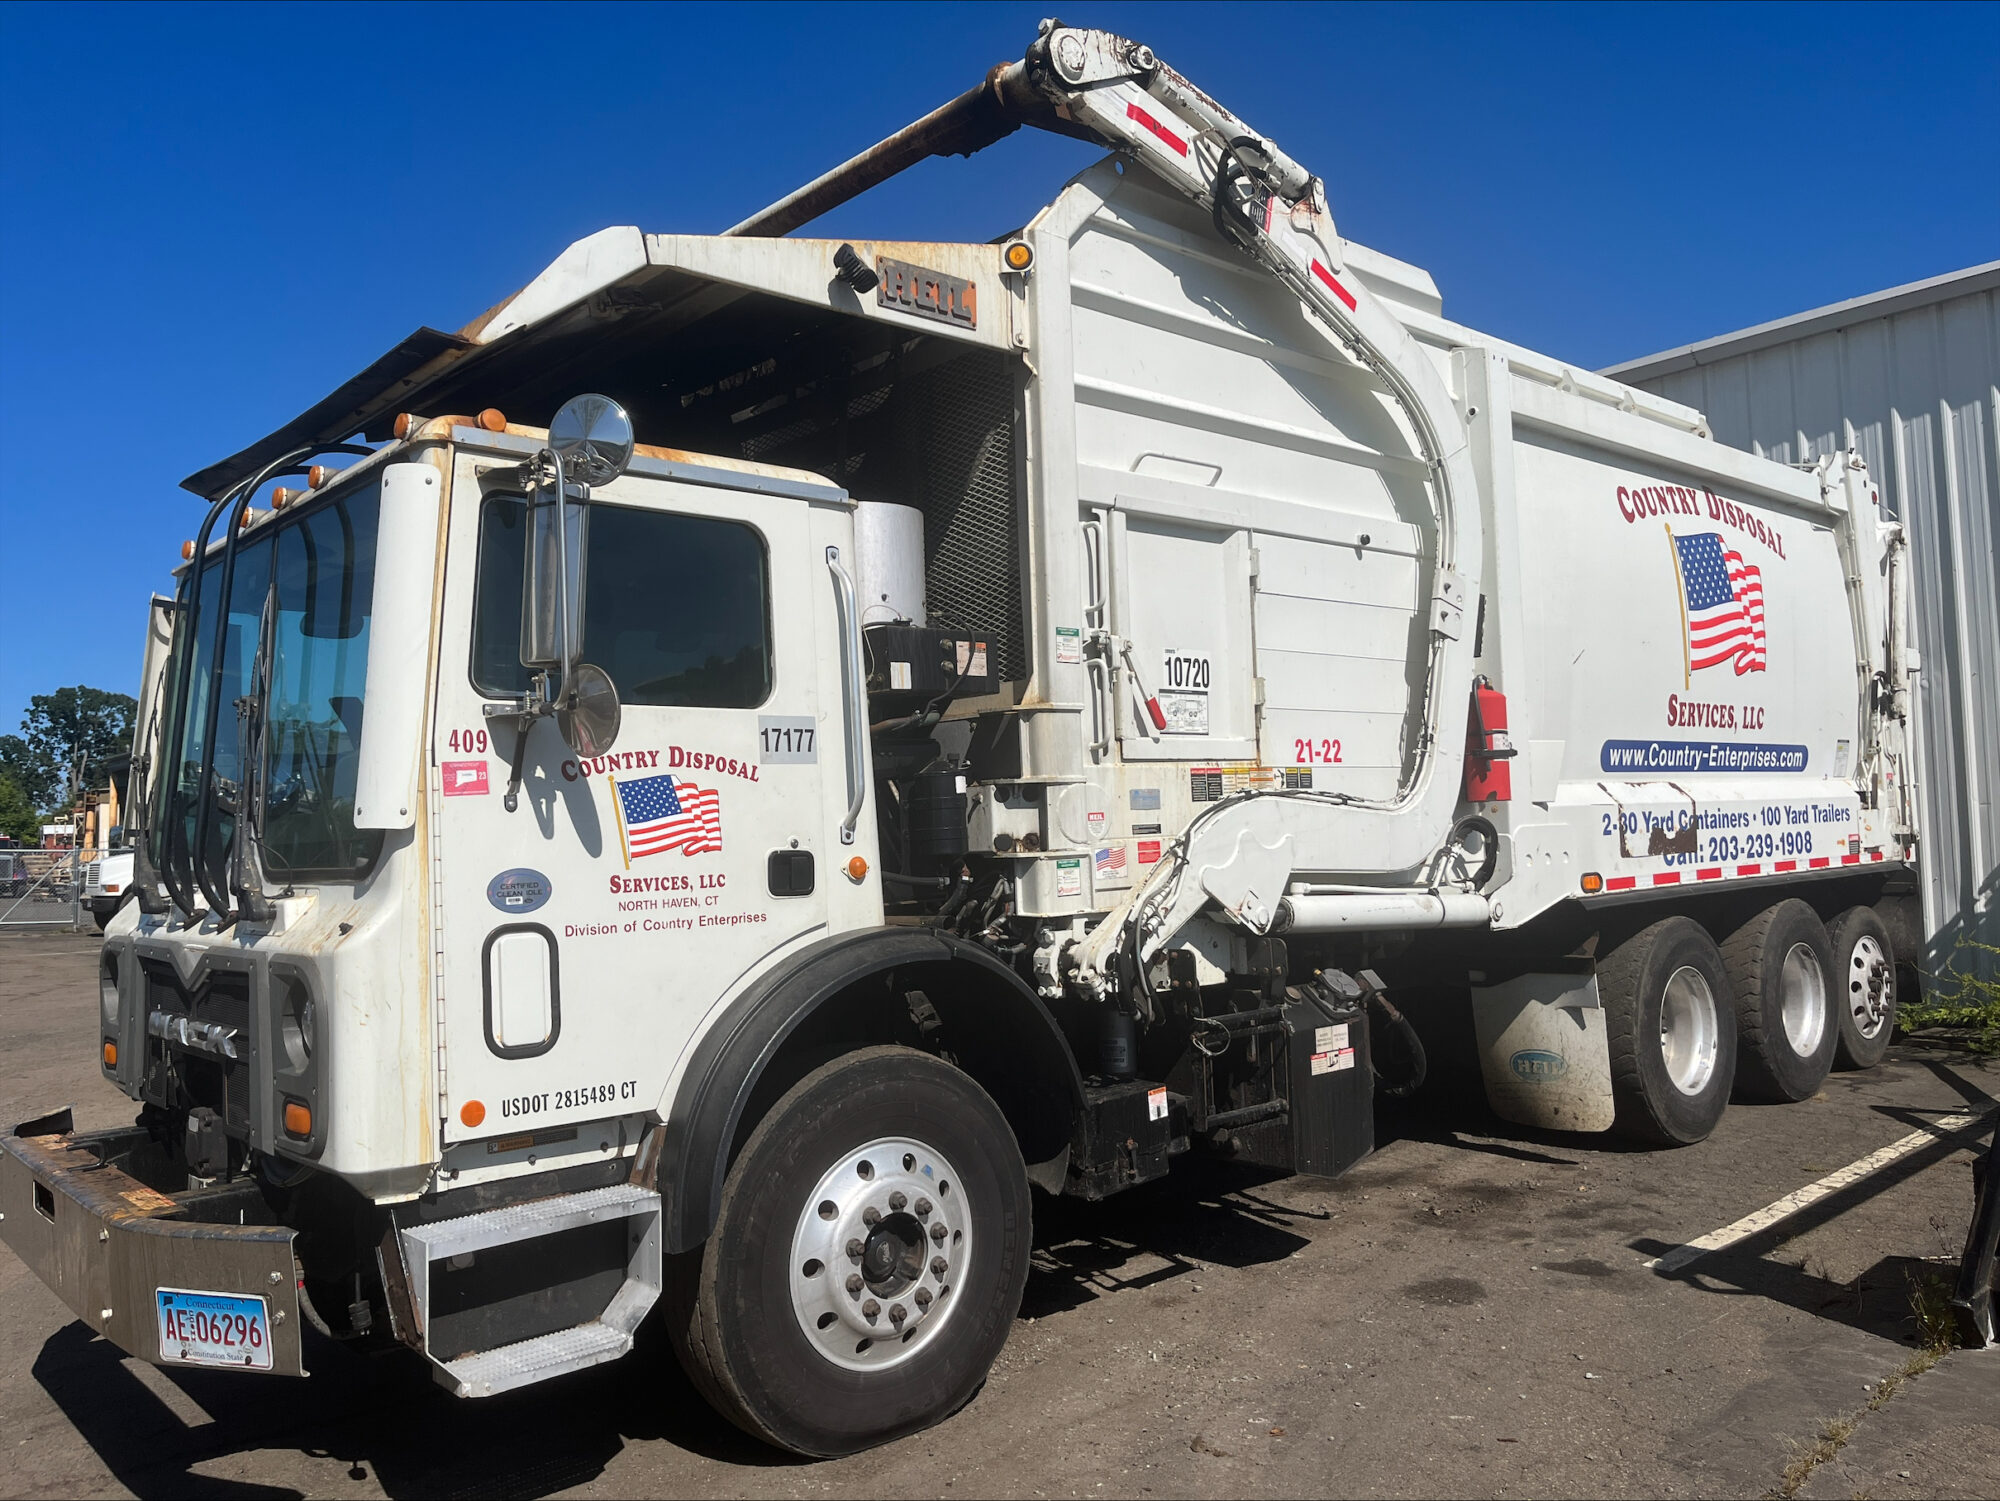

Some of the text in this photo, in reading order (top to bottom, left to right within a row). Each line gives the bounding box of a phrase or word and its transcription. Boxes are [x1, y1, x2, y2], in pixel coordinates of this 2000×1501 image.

[885, 266, 972, 323] HEIL
[1616, 485, 1786, 561] COUNTRY DISPOSAL
[1165, 656, 1210, 688] 10720
[1667, 693, 1765, 734] SERVICES, LLC
[449, 729, 487, 753] 409
[760, 727, 814, 752] 17177
[1295, 738, 1343, 763] 21-22
[561, 746, 760, 783] COUNTRY DISPOSAL
[1609, 743, 1803, 771] www.Country-Enterprises.com
[1641, 810, 1674, 834] Yard
[1760, 806, 1781, 826] 100
[1784, 805, 1809, 825] Yard
[1811, 803, 1851, 823] Trailers
[1708, 831, 1813, 862] 203-239-1908
[500, 882, 539, 890] CERTIFIED
[610, 874, 726, 894] SERVICES, LLC
[618, 896, 719, 912] NORTH HAVEN, CT
[565, 912, 767, 937] Division of Country Enterprises
[502, 1081, 637, 1117] USDOT 2815489 CT
[185, 1297, 235, 1311] Connecticut
[187, 1348, 244, 1361] Constitution State
